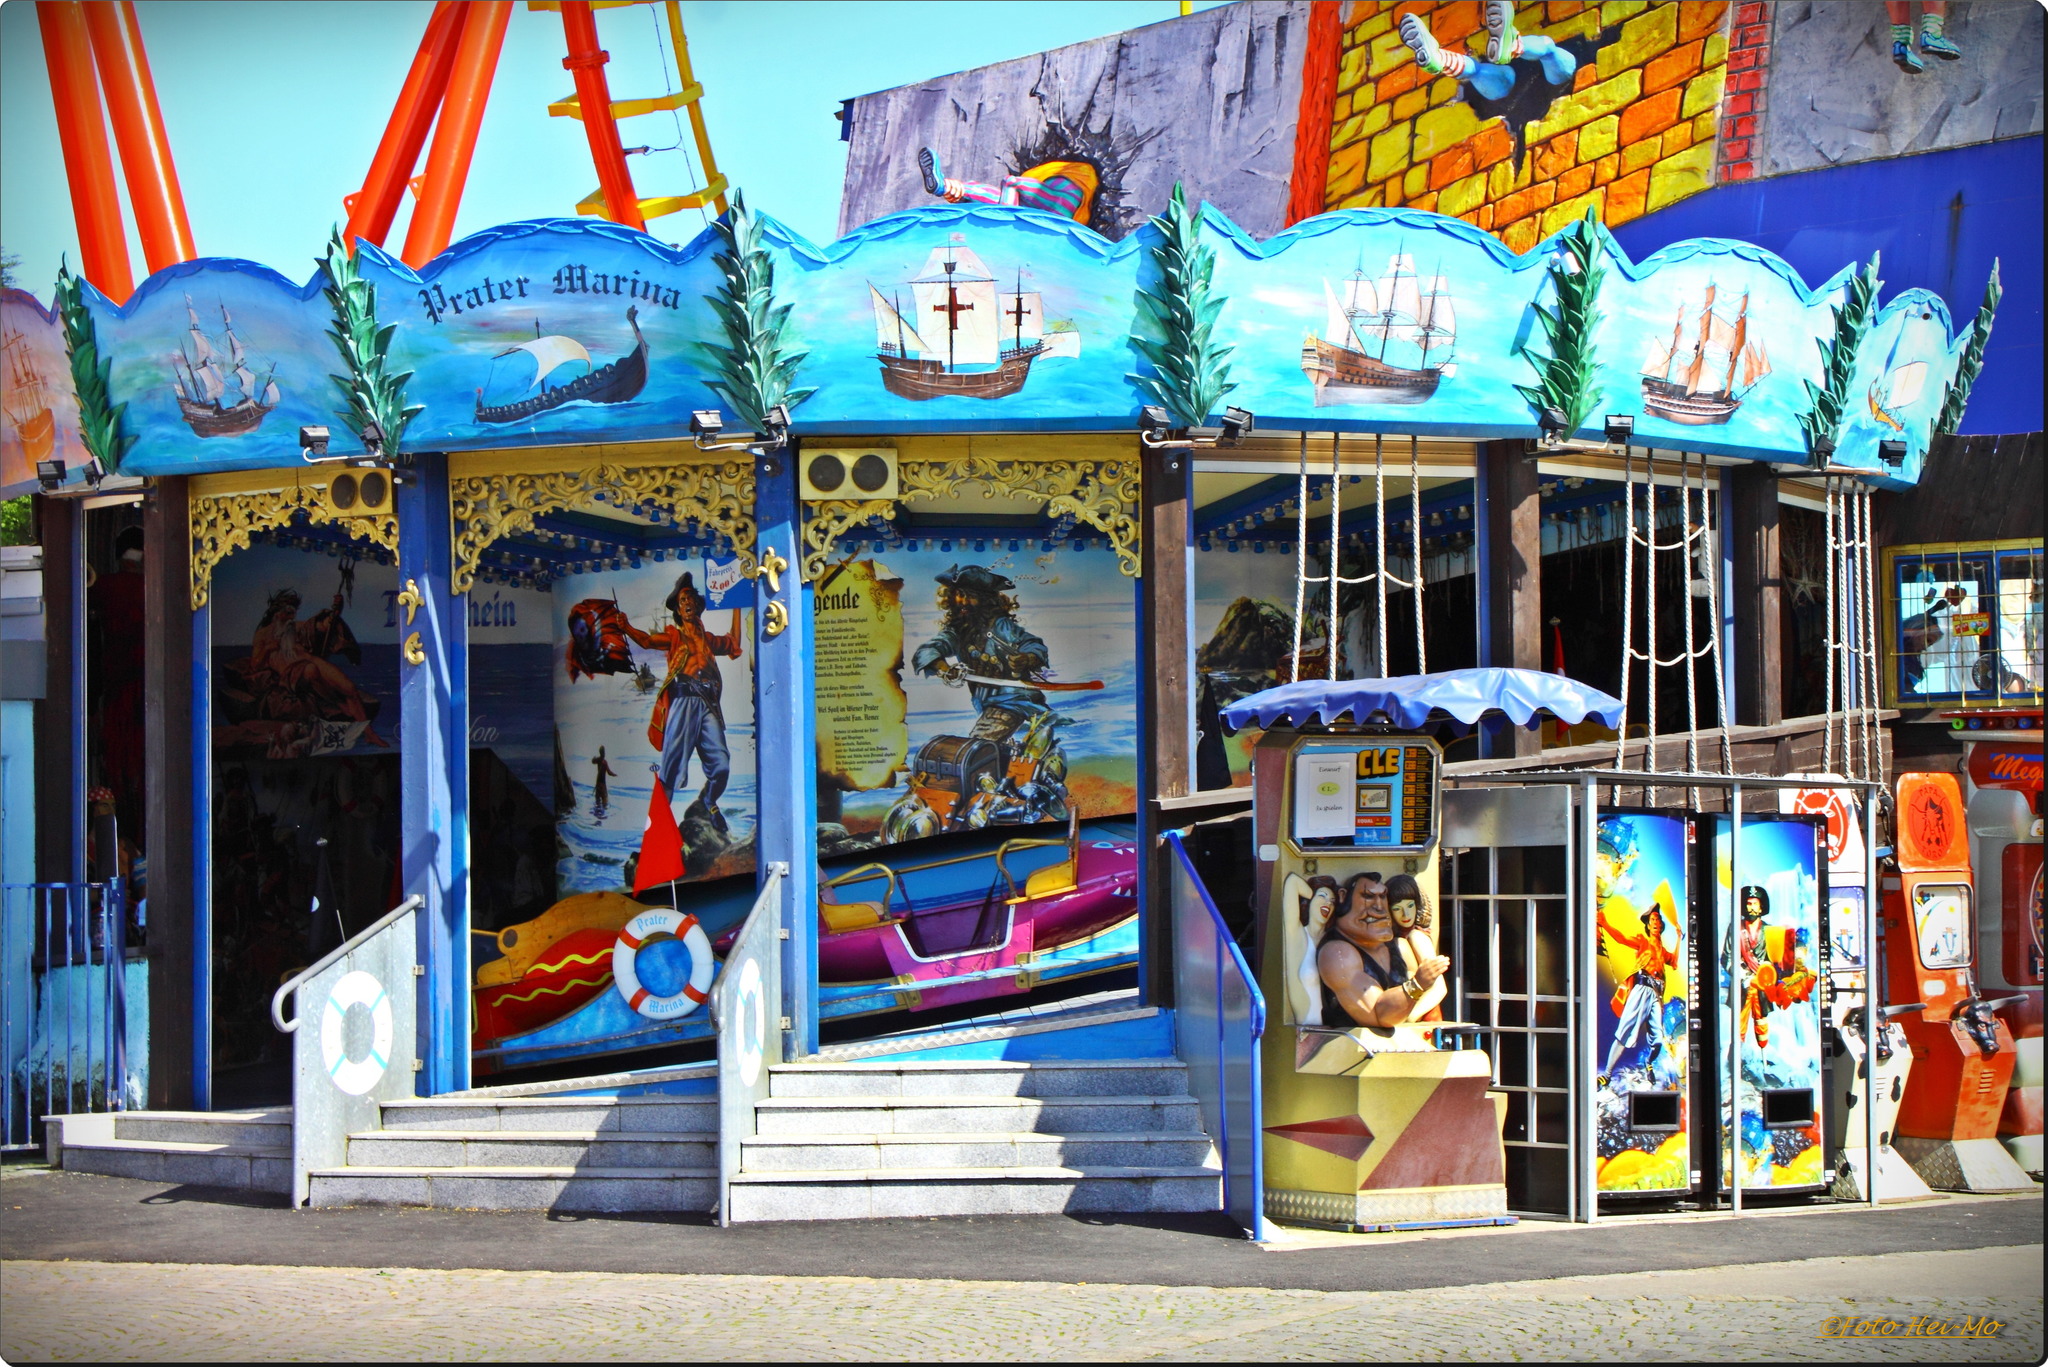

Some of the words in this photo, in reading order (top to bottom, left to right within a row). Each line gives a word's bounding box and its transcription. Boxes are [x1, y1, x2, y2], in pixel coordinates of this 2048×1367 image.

[418, 275, 530, 326] Prater
[552, 263, 682, 310] Marina
[814, 586, 860, 616] gende
[636, 914, 668, 932] Prater
[648, 998, 684, 1013] Marina
